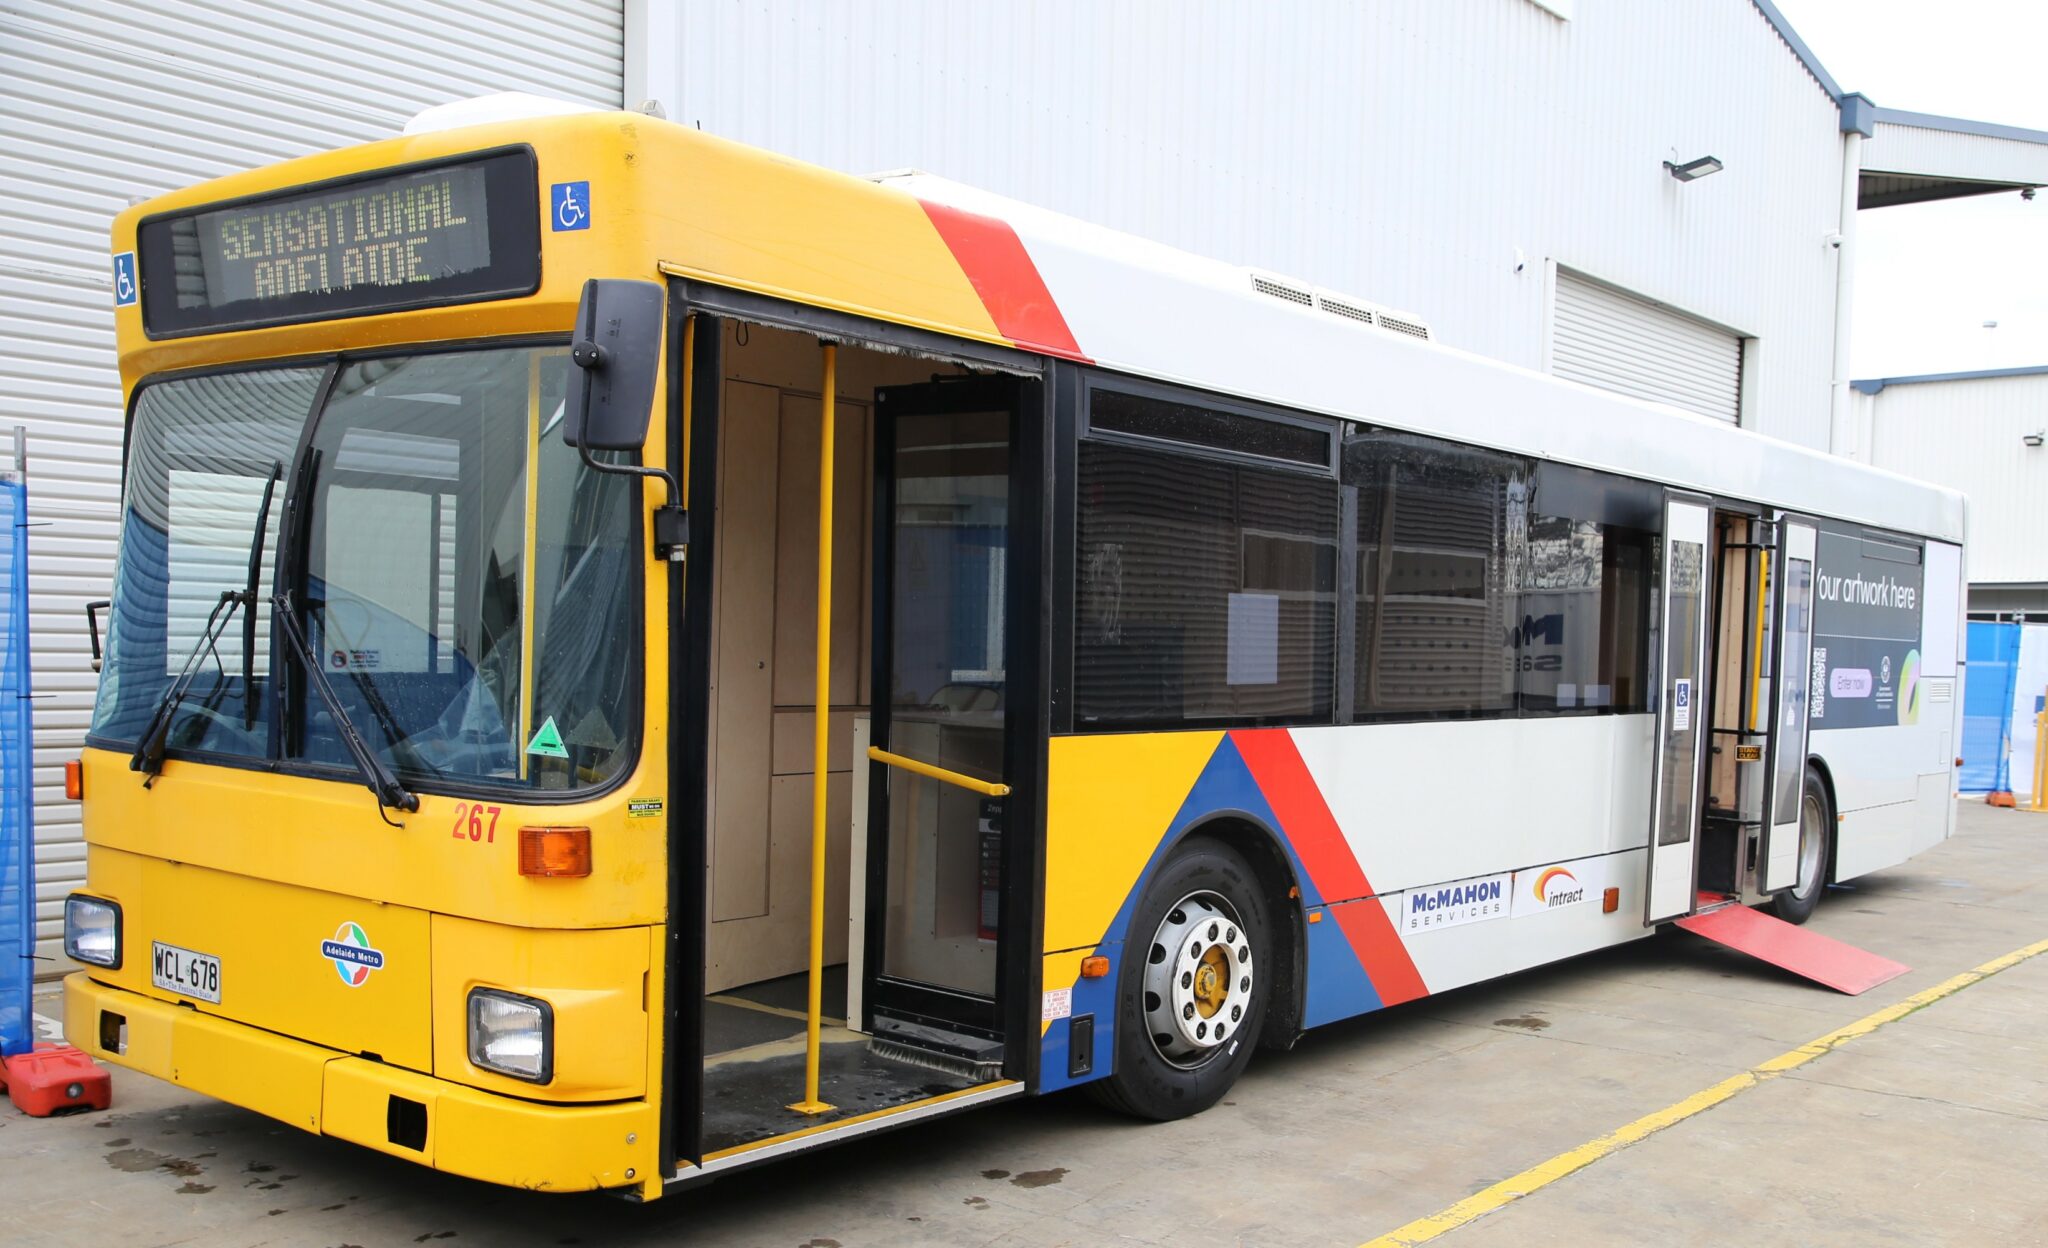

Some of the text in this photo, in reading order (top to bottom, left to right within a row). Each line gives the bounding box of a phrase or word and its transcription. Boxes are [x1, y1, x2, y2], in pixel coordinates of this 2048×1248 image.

[221, 180, 467, 261] SENSATIONAL
[1843, 572, 1889, 607] artwork
[1890, 576, 1916, 609] here
[453, 802, 501, 843] 267
[1412, 880, 1501, 914] McMAHON
[1548, 887, 1584, 908] intract
[1411, 903, 1501, 929] SERVICES
[155, 946, 218, 992] WCL 678
[326, 945, 379, 964] Adelaide Metro
